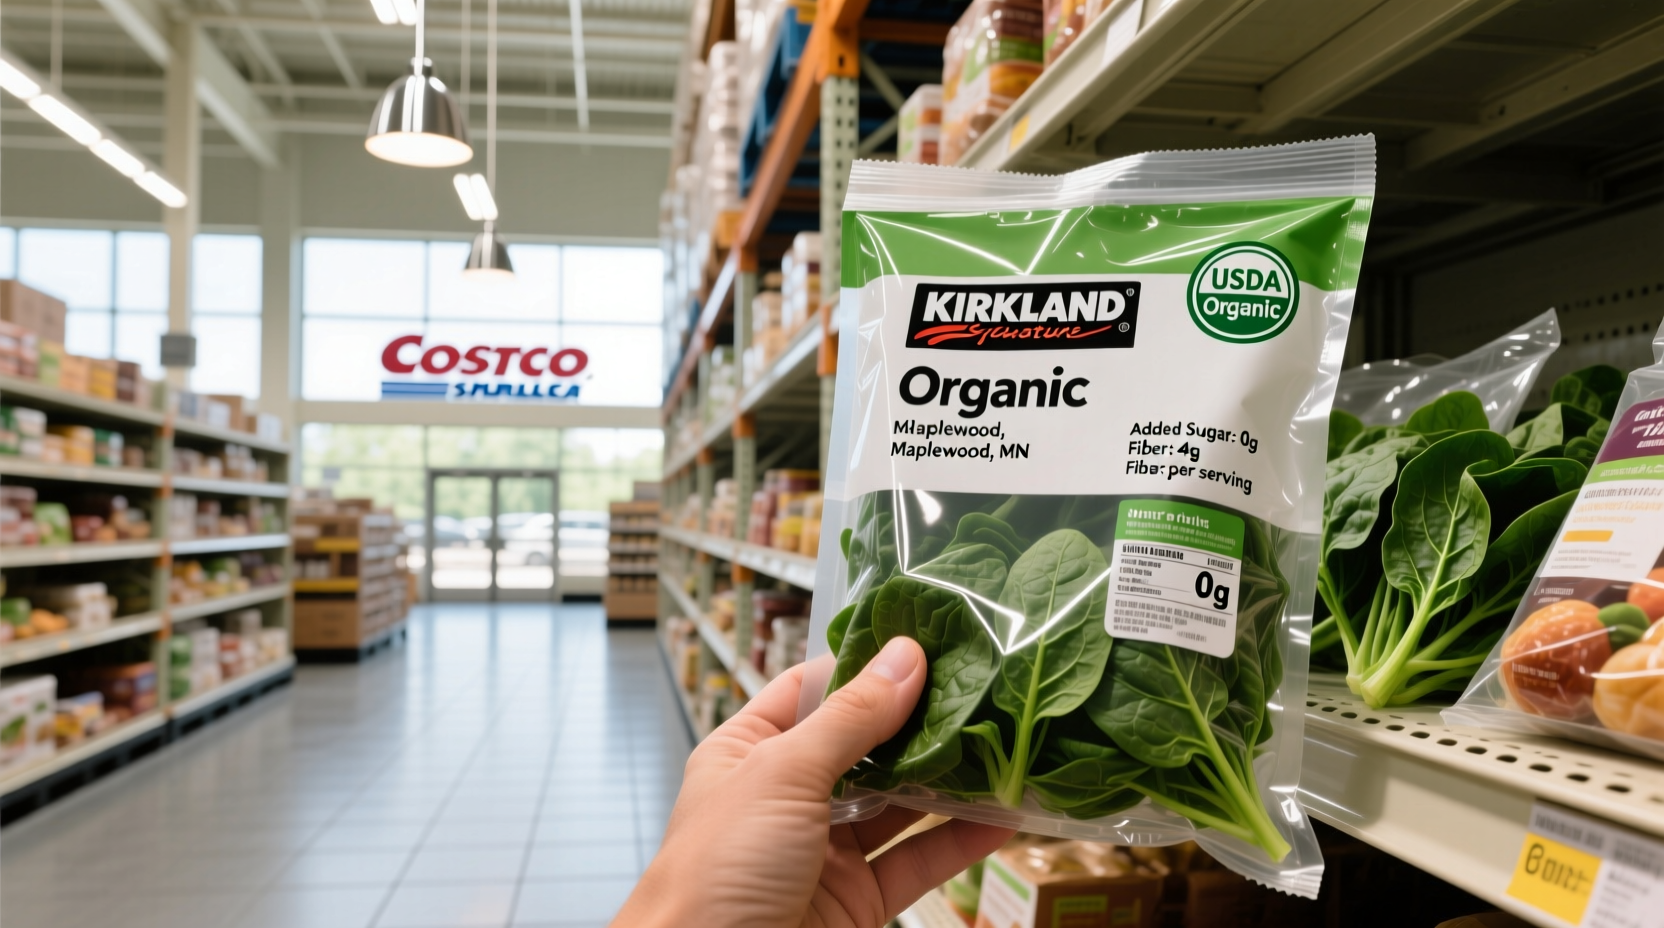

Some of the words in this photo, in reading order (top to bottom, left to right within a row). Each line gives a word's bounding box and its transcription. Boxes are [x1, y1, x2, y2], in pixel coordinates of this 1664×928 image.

[1212, 268, 1282, 292] USDA
[923, 291, 1126, 322] KIRKLAND
[1203, 296, 1281, 320] Organic
[899, 366, 1090, 418] Organic
[891, 441, 994, 462] Maplewood,
[999, 443, 1030, 459] MN
[1128, 439, 1174, 456] Fiber:
[1177, 441, 1200, 462] 4g
[1129, 421, 1182, 436] Added
[1185, 422, 1237, 443] Sugar:
[1240, 430, 1259, 454] 0g
[1167, 465, 1196, 481] per
[1199, 468, 1253, 496] serving
[1195, 571, 1230, 610] 0g
